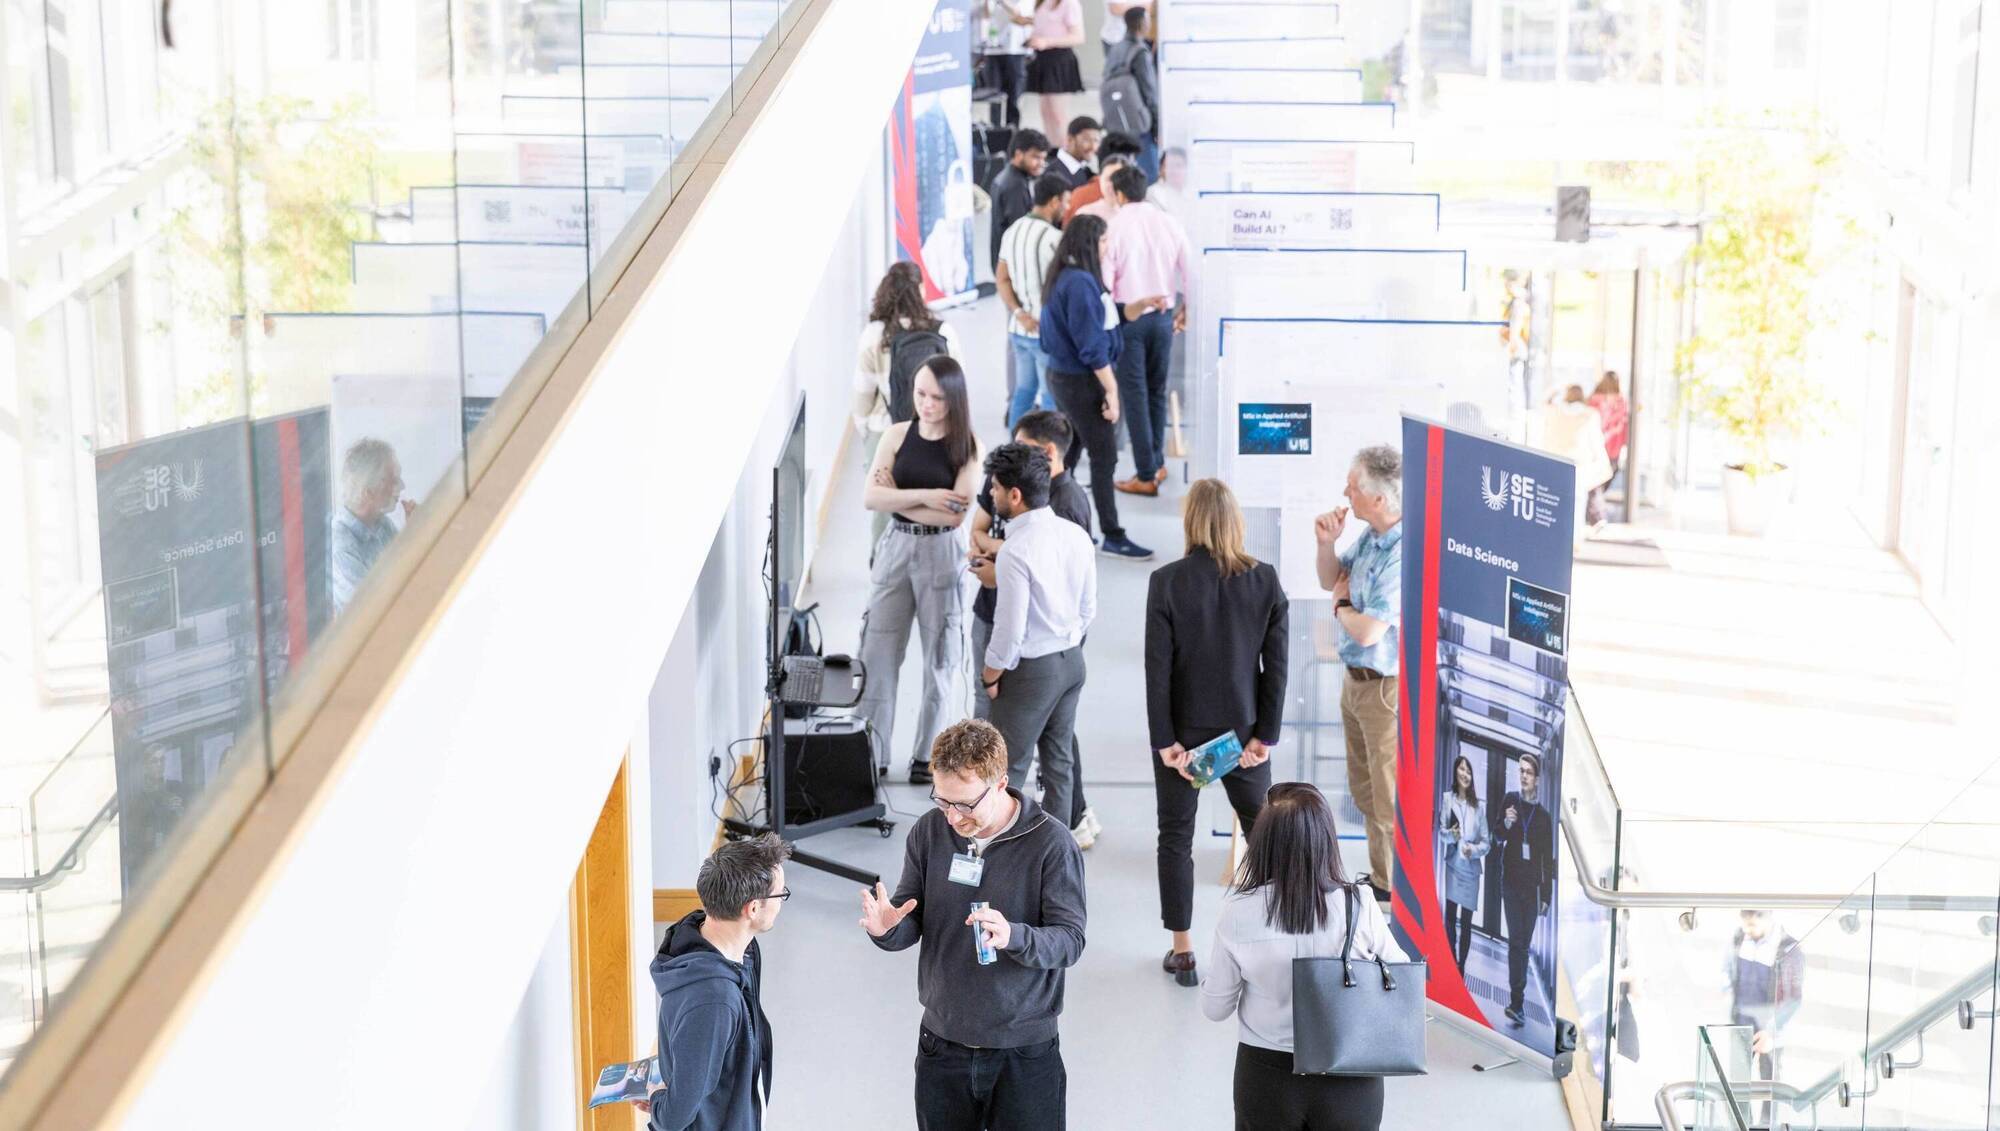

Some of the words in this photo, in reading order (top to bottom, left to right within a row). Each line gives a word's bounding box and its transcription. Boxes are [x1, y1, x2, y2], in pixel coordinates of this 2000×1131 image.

[1233, 209, 1257, 219] Can
[1259, 210, 1272, 219] AI
[1233, 224, 1262, 234] Build
[1264, 225, 1276, 234] AI
[1510, 473, 1535, 499] SE
[1510, 494, 1534, 521] TU
[1447, 537, 1473, 558] Data
[1474, 547, 1519, 573] Science
